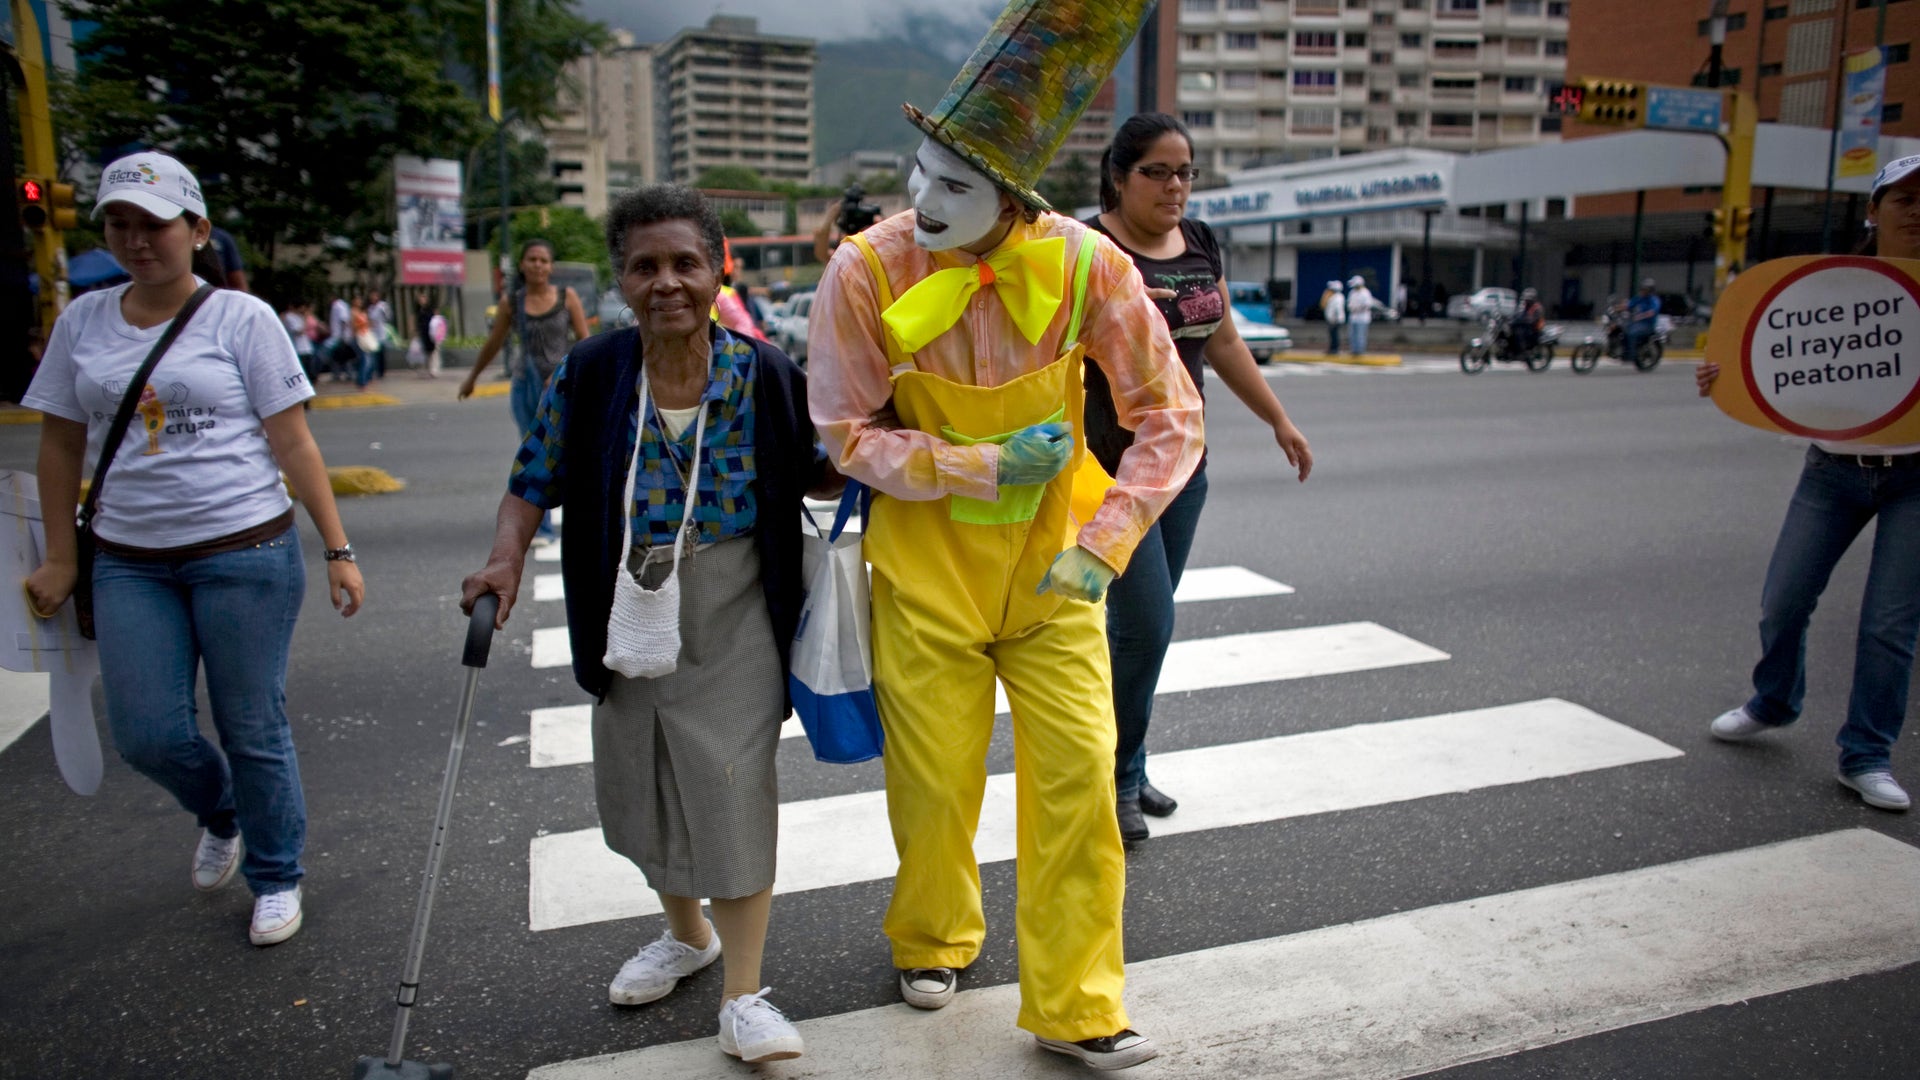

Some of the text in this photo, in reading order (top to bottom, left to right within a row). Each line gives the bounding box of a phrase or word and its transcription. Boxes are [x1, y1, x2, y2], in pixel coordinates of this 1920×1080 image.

[1768, 296, 1904, 330] Cruce por
[1770, 324, 1903, 359] el rayado
[1774, 353, 1901, 394] peatonal
[165, 418, 217, 435] cruza
[167, 404, 202, 418] mira
[207, 405, 217, 417] y
